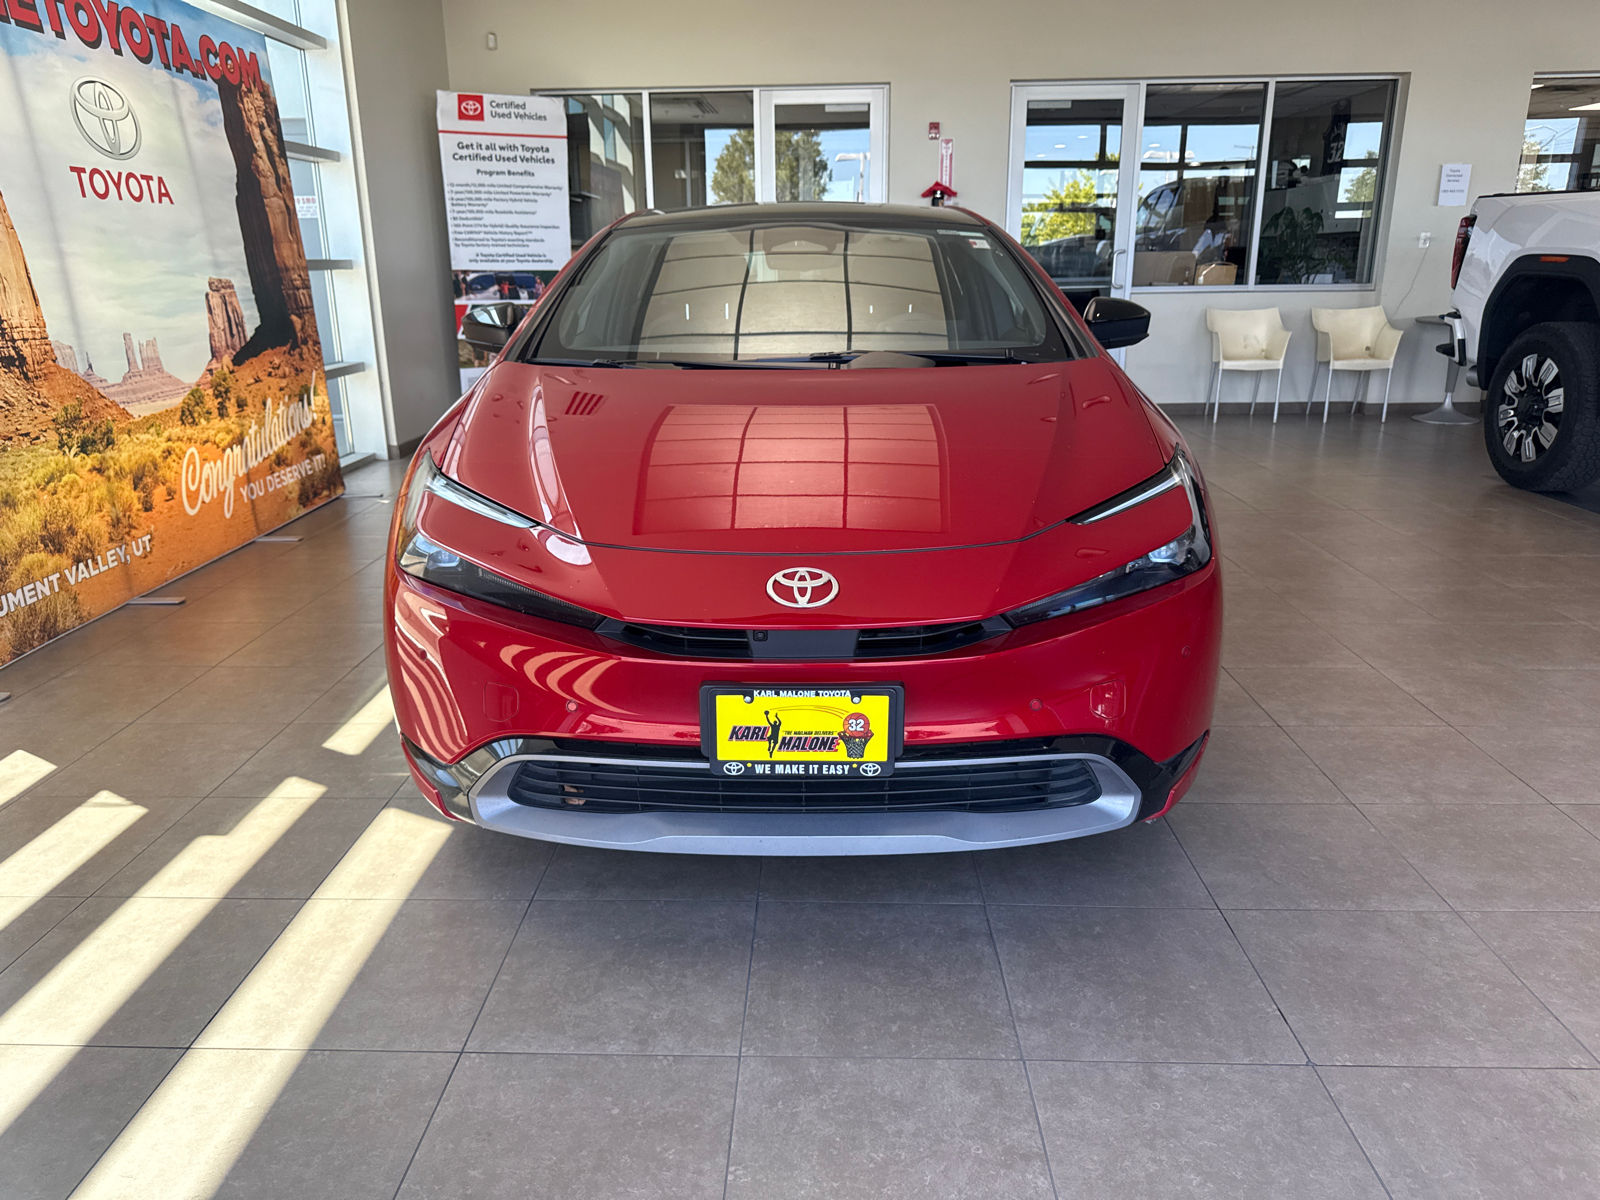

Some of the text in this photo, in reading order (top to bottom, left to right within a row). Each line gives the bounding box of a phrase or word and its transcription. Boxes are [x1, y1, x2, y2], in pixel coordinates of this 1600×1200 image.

[0, 0, 263, 92] ETOYOTA.COM
[490, 100, 526, 110] Certified
[491, 111, 547, 121] Used Vehicles
[457, 142, 550, 154] Get it all with Toyota
[1327, 141, 1345, 163] 32
[452, 153, 555, 164] Certified Used Vehicles
[476, 169, 535, 177] Program Benefits
[69, 166, 174, 205] TOYOTA
[182, 370, 318, 519] Congratulations!
[240, 453, 326, 503] YOU DESERVE IT!
[64, 544, 131, 586] VALLEY,
[132, 534, 152, 557] UT
[728, 725, 770, 741] KARL
[848, 719, 865, 731] 32
[777, 735, 839, 752] MALONE
[755, 764, 850, 775] WE MAKE IT EASY
